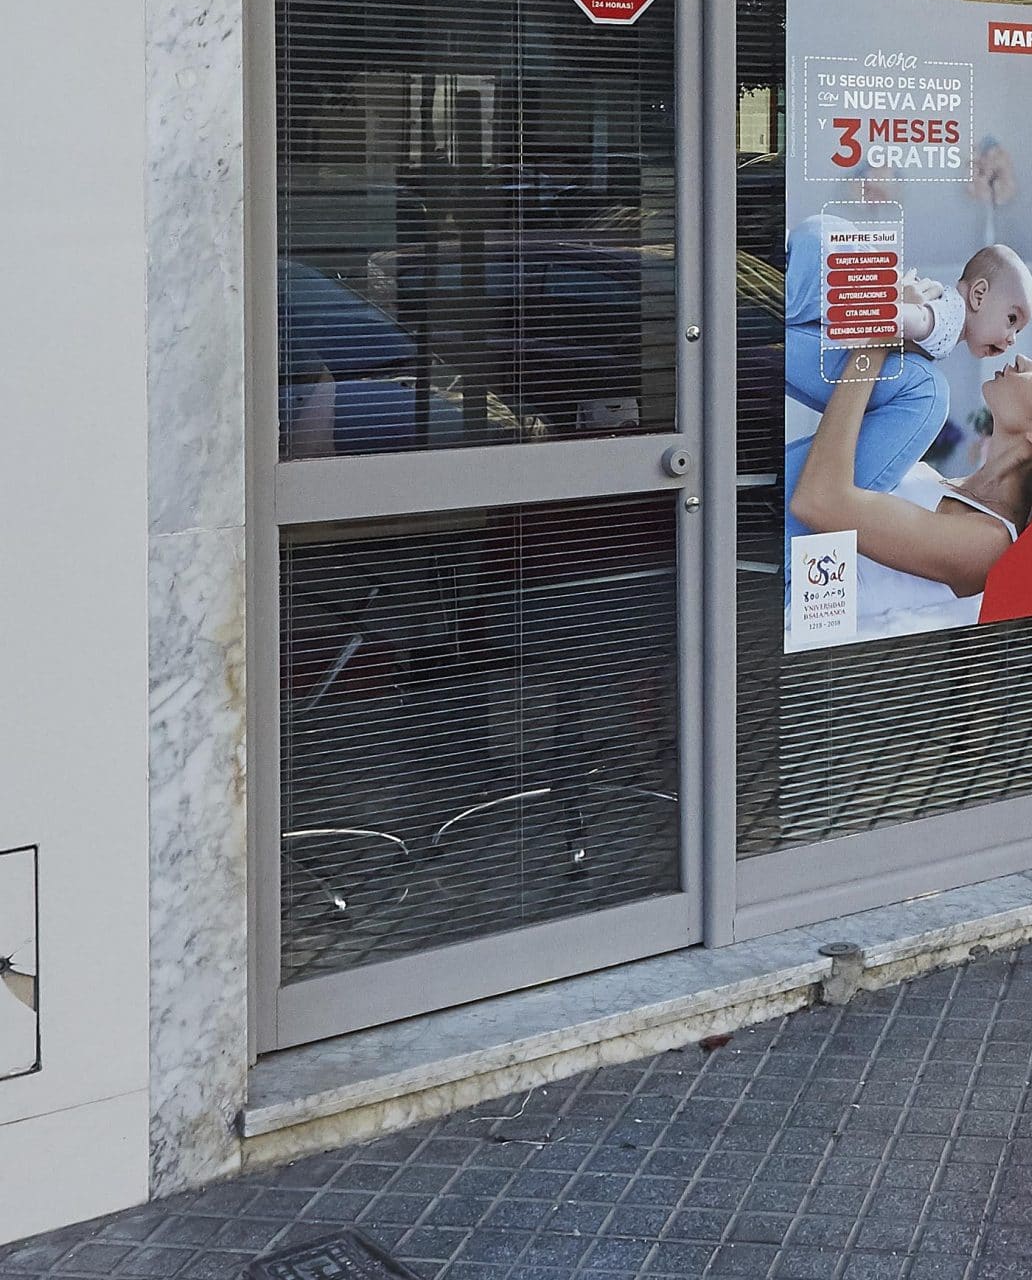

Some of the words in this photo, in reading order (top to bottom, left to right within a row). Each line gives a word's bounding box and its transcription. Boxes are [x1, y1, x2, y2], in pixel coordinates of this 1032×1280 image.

[864, 49, 918, 71] ahora
[817, 74, 835, 87] TU
[839, 75, 894, 89] SEGURO
[898, 77, 915, 89] DE
[919, 78, 961, 91] SALUD
[844, 91, 916, 111] NUEVA
[921, 93, 961, 111] APP
[818, 119, 827, 130] Y
[831, 118, 862, 168] 3
[869, 118, 960, 144] MESES
[867, 145, 961, 168] GRATIS
[830, 234, 870, 242] MAPFRE
[872, 233, 895, 242] Salud
[836, 257, 859, 266] TARJETA
[860, 256, 890, 264] SANITARIA
[847, 274, 878, 282] BUSCADOR
[838, 291, 887, 300] AUTORIZACIONES
